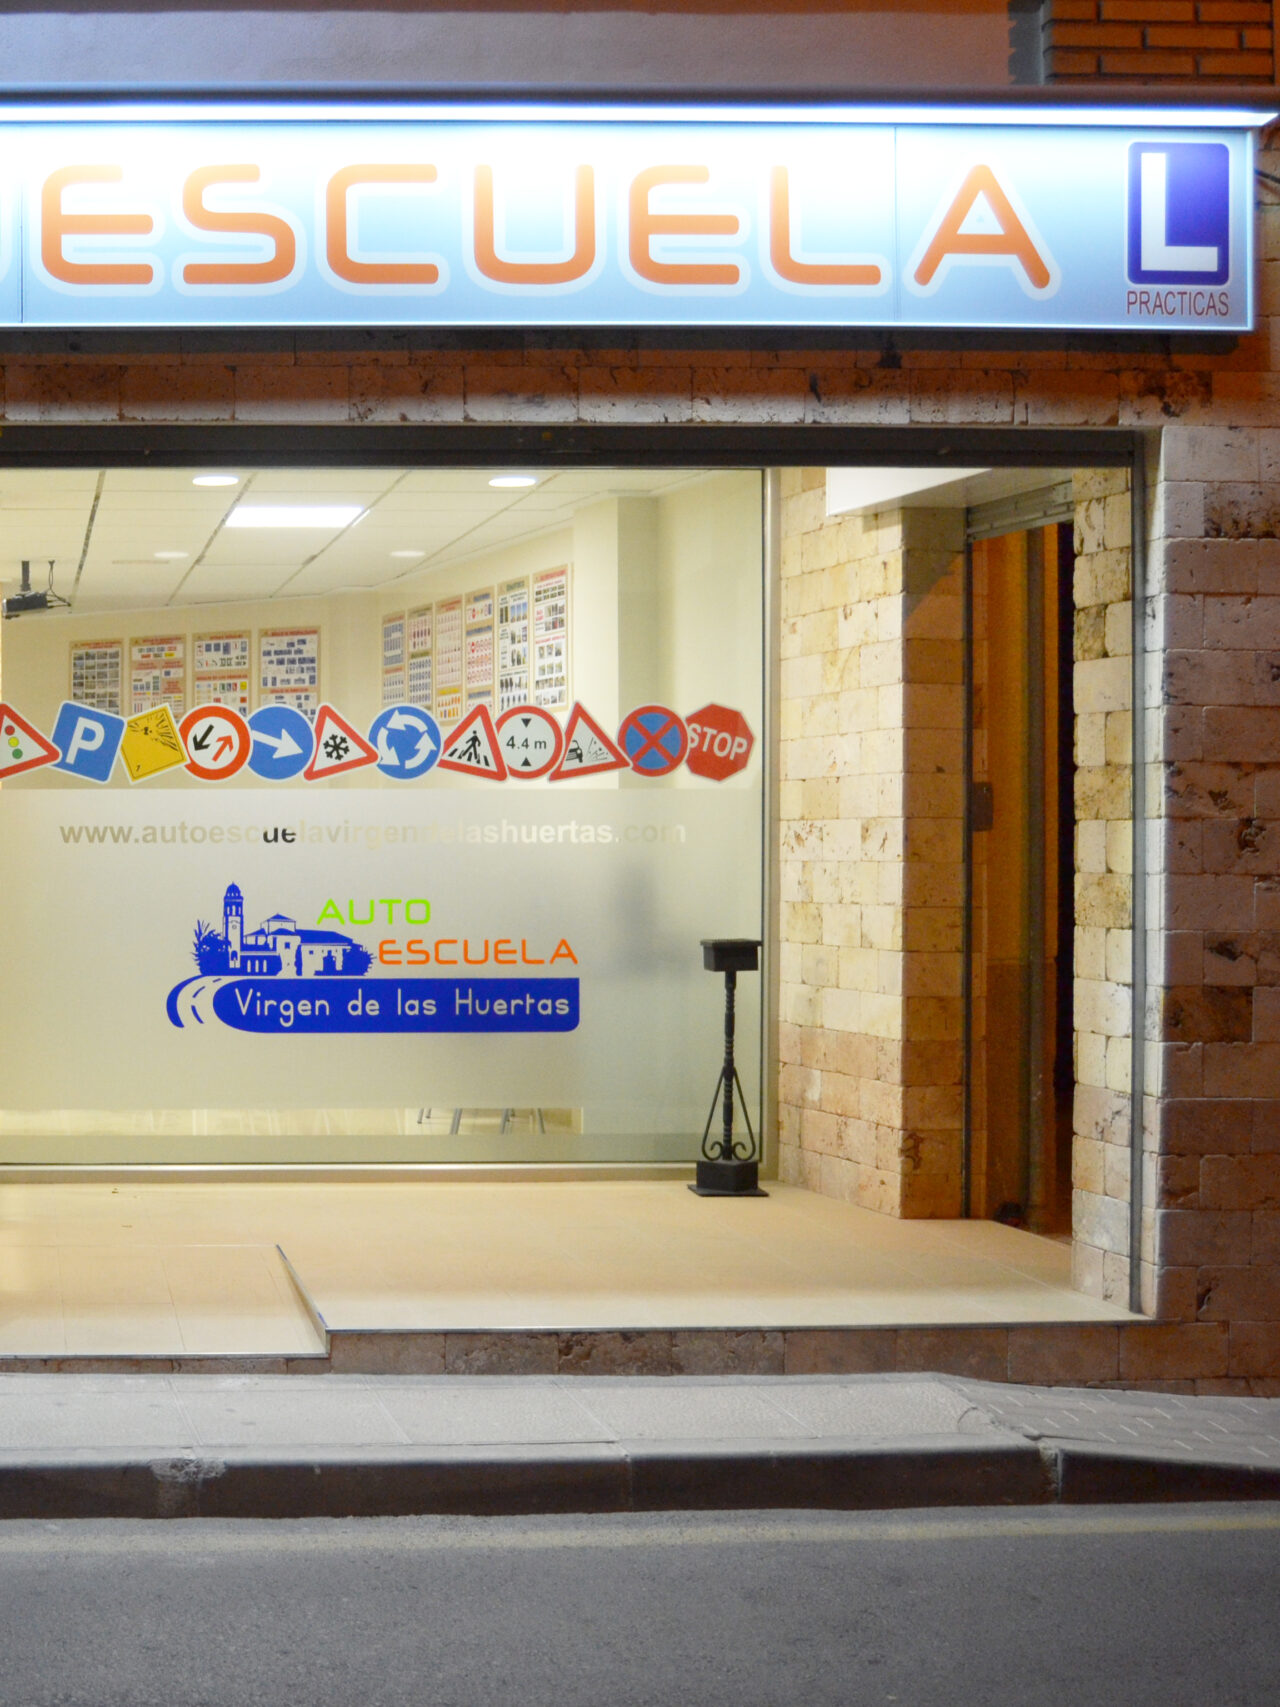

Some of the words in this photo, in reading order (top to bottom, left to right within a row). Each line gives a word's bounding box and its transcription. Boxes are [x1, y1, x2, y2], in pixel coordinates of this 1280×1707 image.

[1141, 152, 1219, 272] L
[1126, 291, 1230, 317] PRACTICAS
[65, 716, 105, 765] P
[506, 736, 530, 750] 4.4
[687, 723, 749, 762] STOP
[59, 819, 687, 850] www.autoescuelavirgendelashuertas.com
[316, 899, 432, 925] AUTO
[378, 939, 579, 965] ESCUELA
[234, 988, 330, 1027] Virgen
[346, 988, 381, 1016] de
[396, 988, 437, 1016] las
[455, 987, 570, 1016] Huertas
